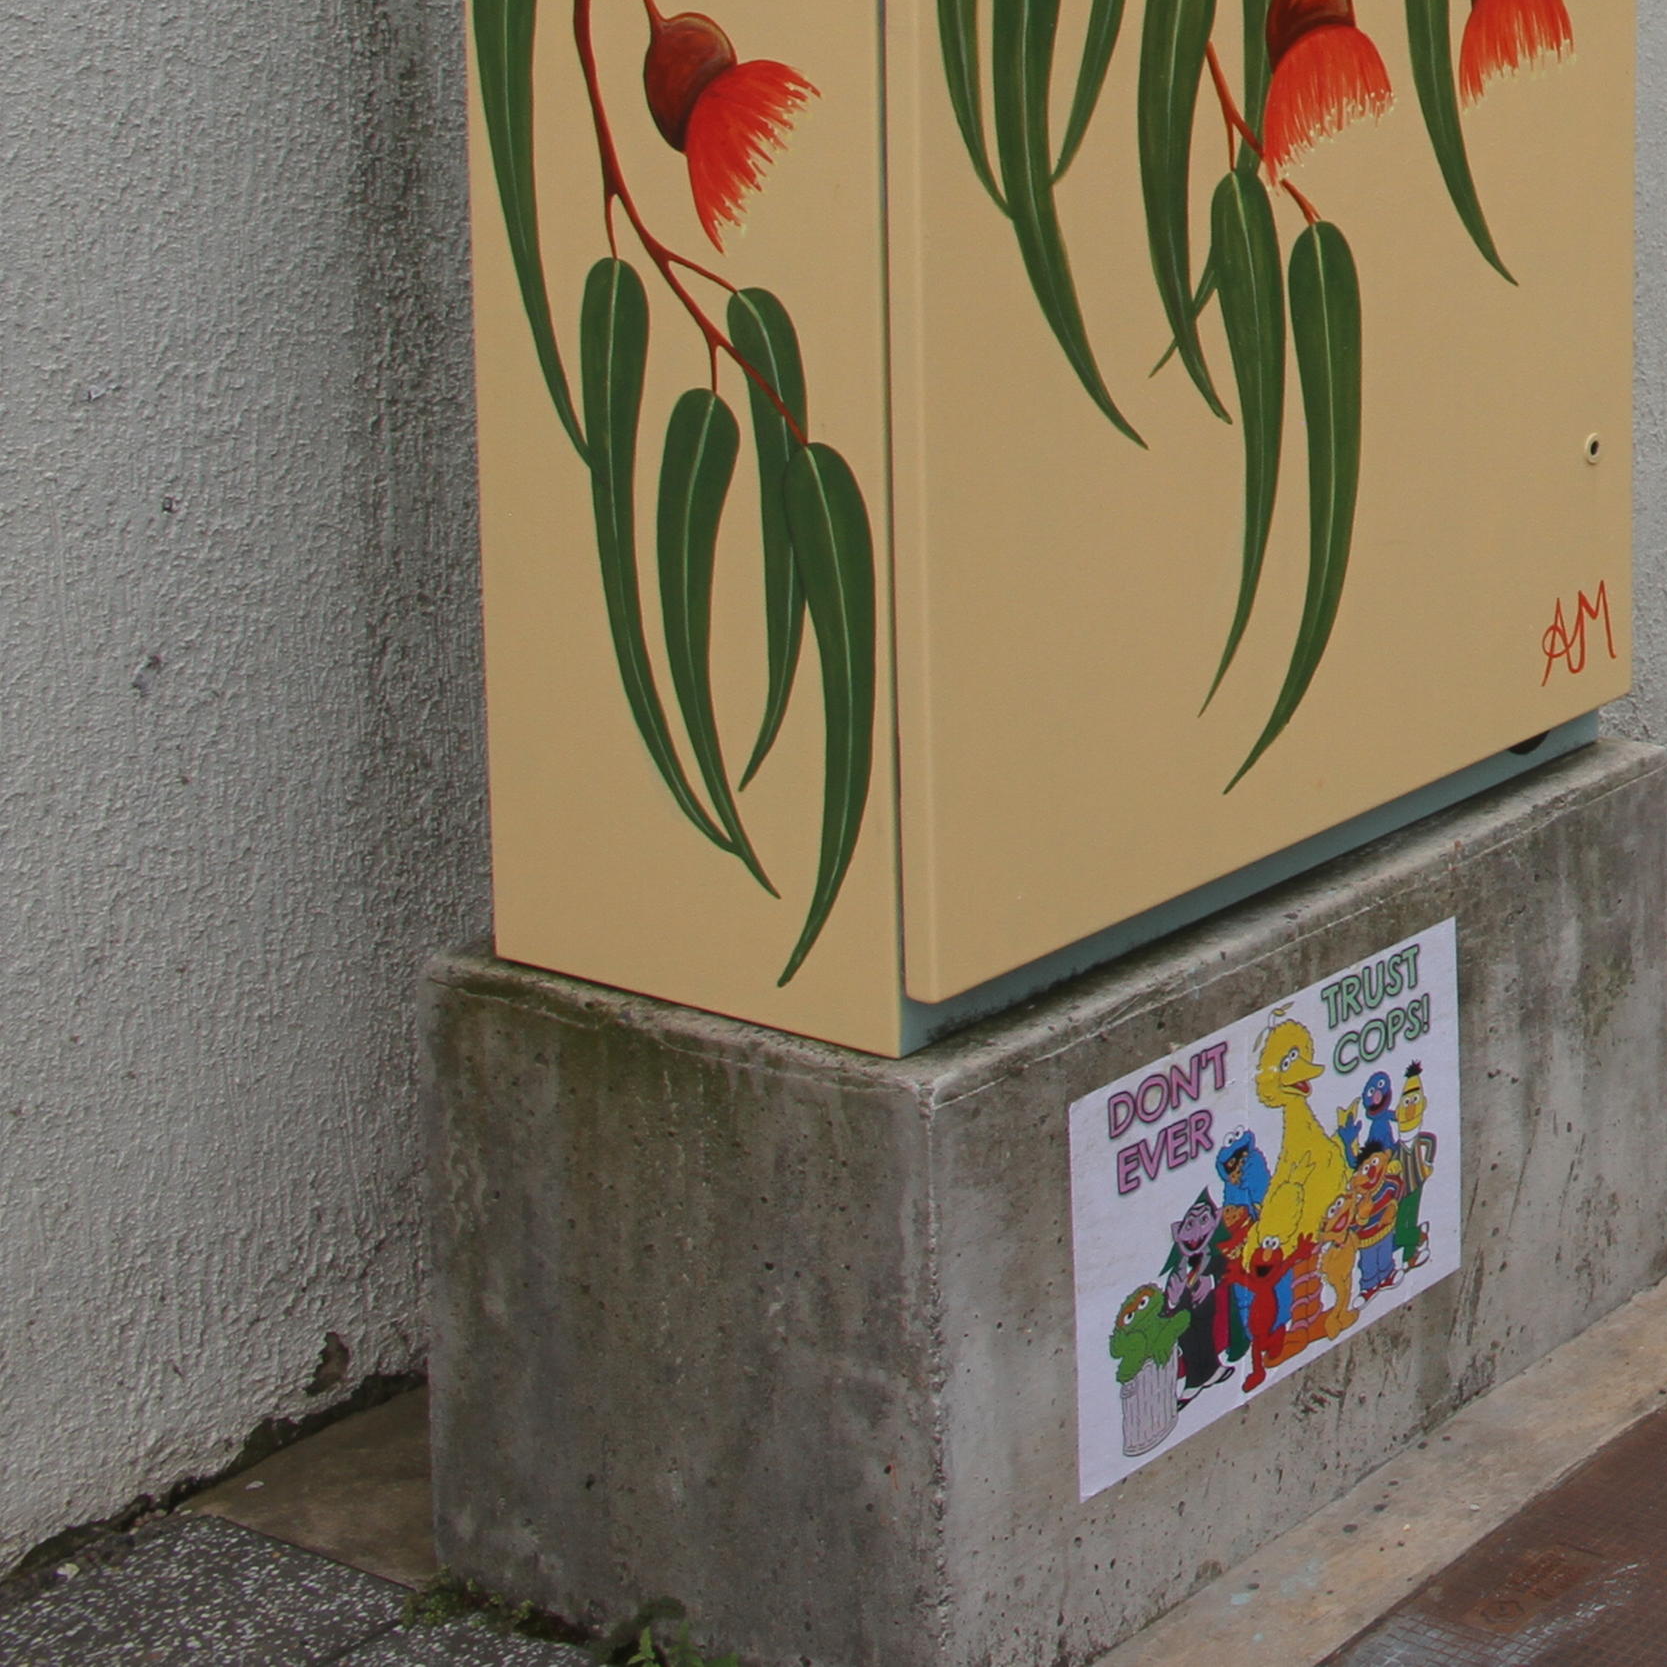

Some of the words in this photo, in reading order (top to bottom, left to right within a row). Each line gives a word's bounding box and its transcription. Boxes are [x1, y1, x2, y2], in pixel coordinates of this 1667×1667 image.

[1320, 942, 1421, 1030] TRUST
[1332, 994, 1431, 1075] COPS!
[1107, 1040, 1229, 1141] DON'T
[1116, 1109, 1214, 1195] EVER
